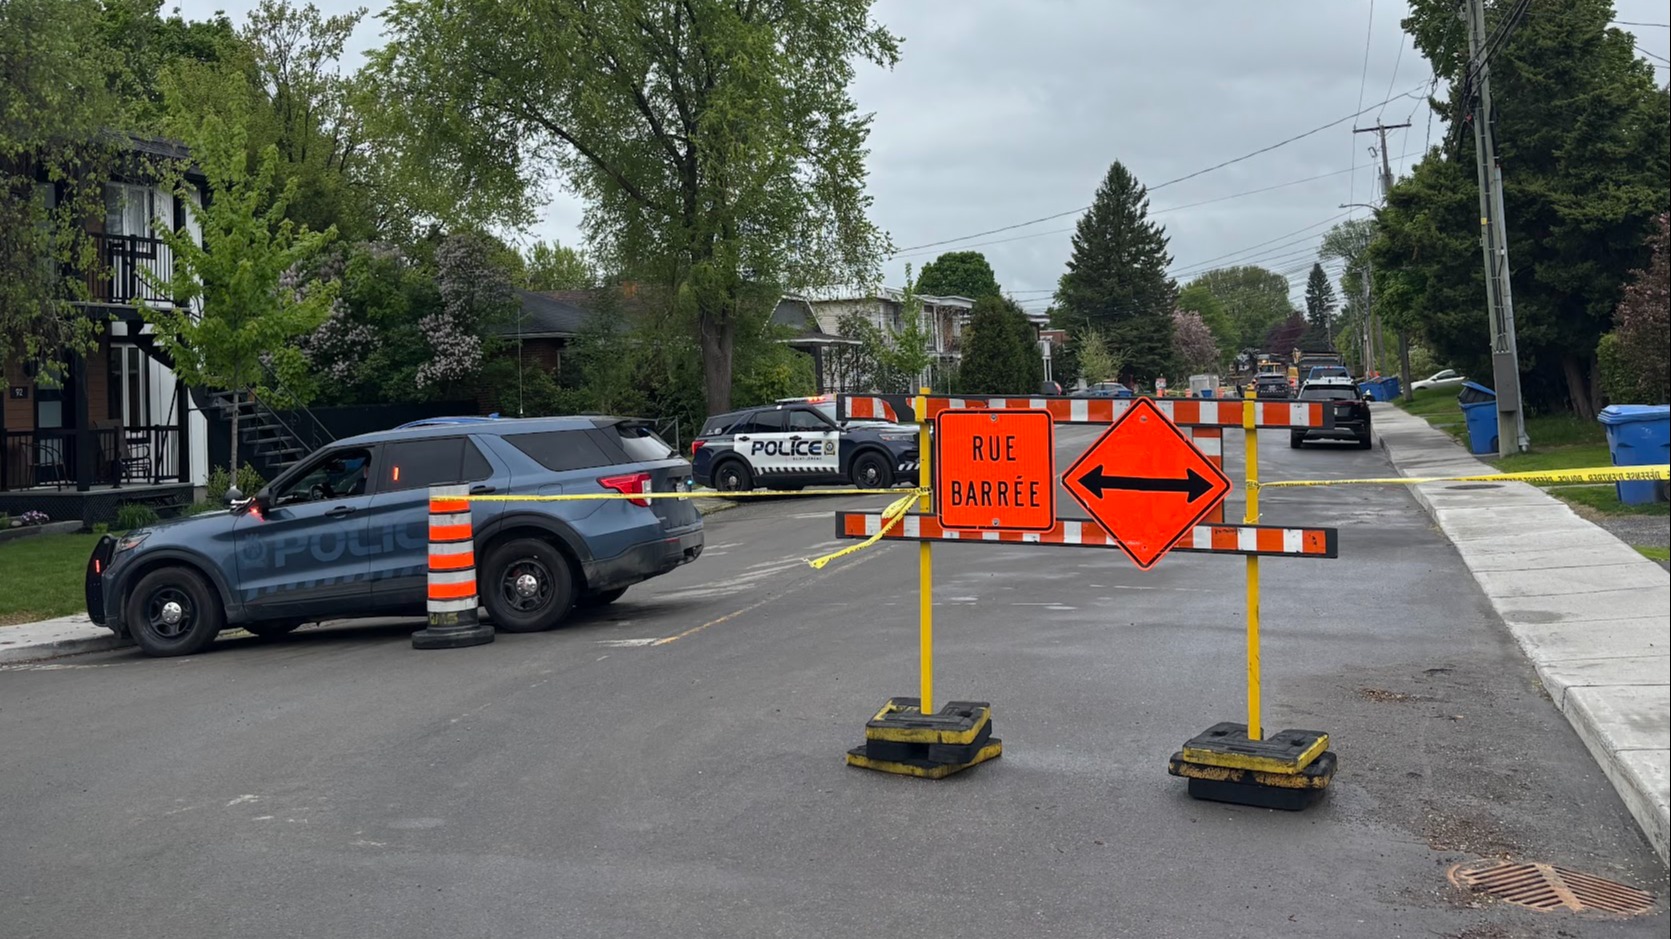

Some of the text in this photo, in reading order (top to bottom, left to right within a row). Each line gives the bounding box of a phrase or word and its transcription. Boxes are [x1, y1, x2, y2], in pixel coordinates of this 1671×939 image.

[751, 440, 822, 456] POLICE
[973, 435, 1017, 461] RUE
[951, 475, 1040, 507] BARRÉE
[274, 516, 427, 568] POLIC
